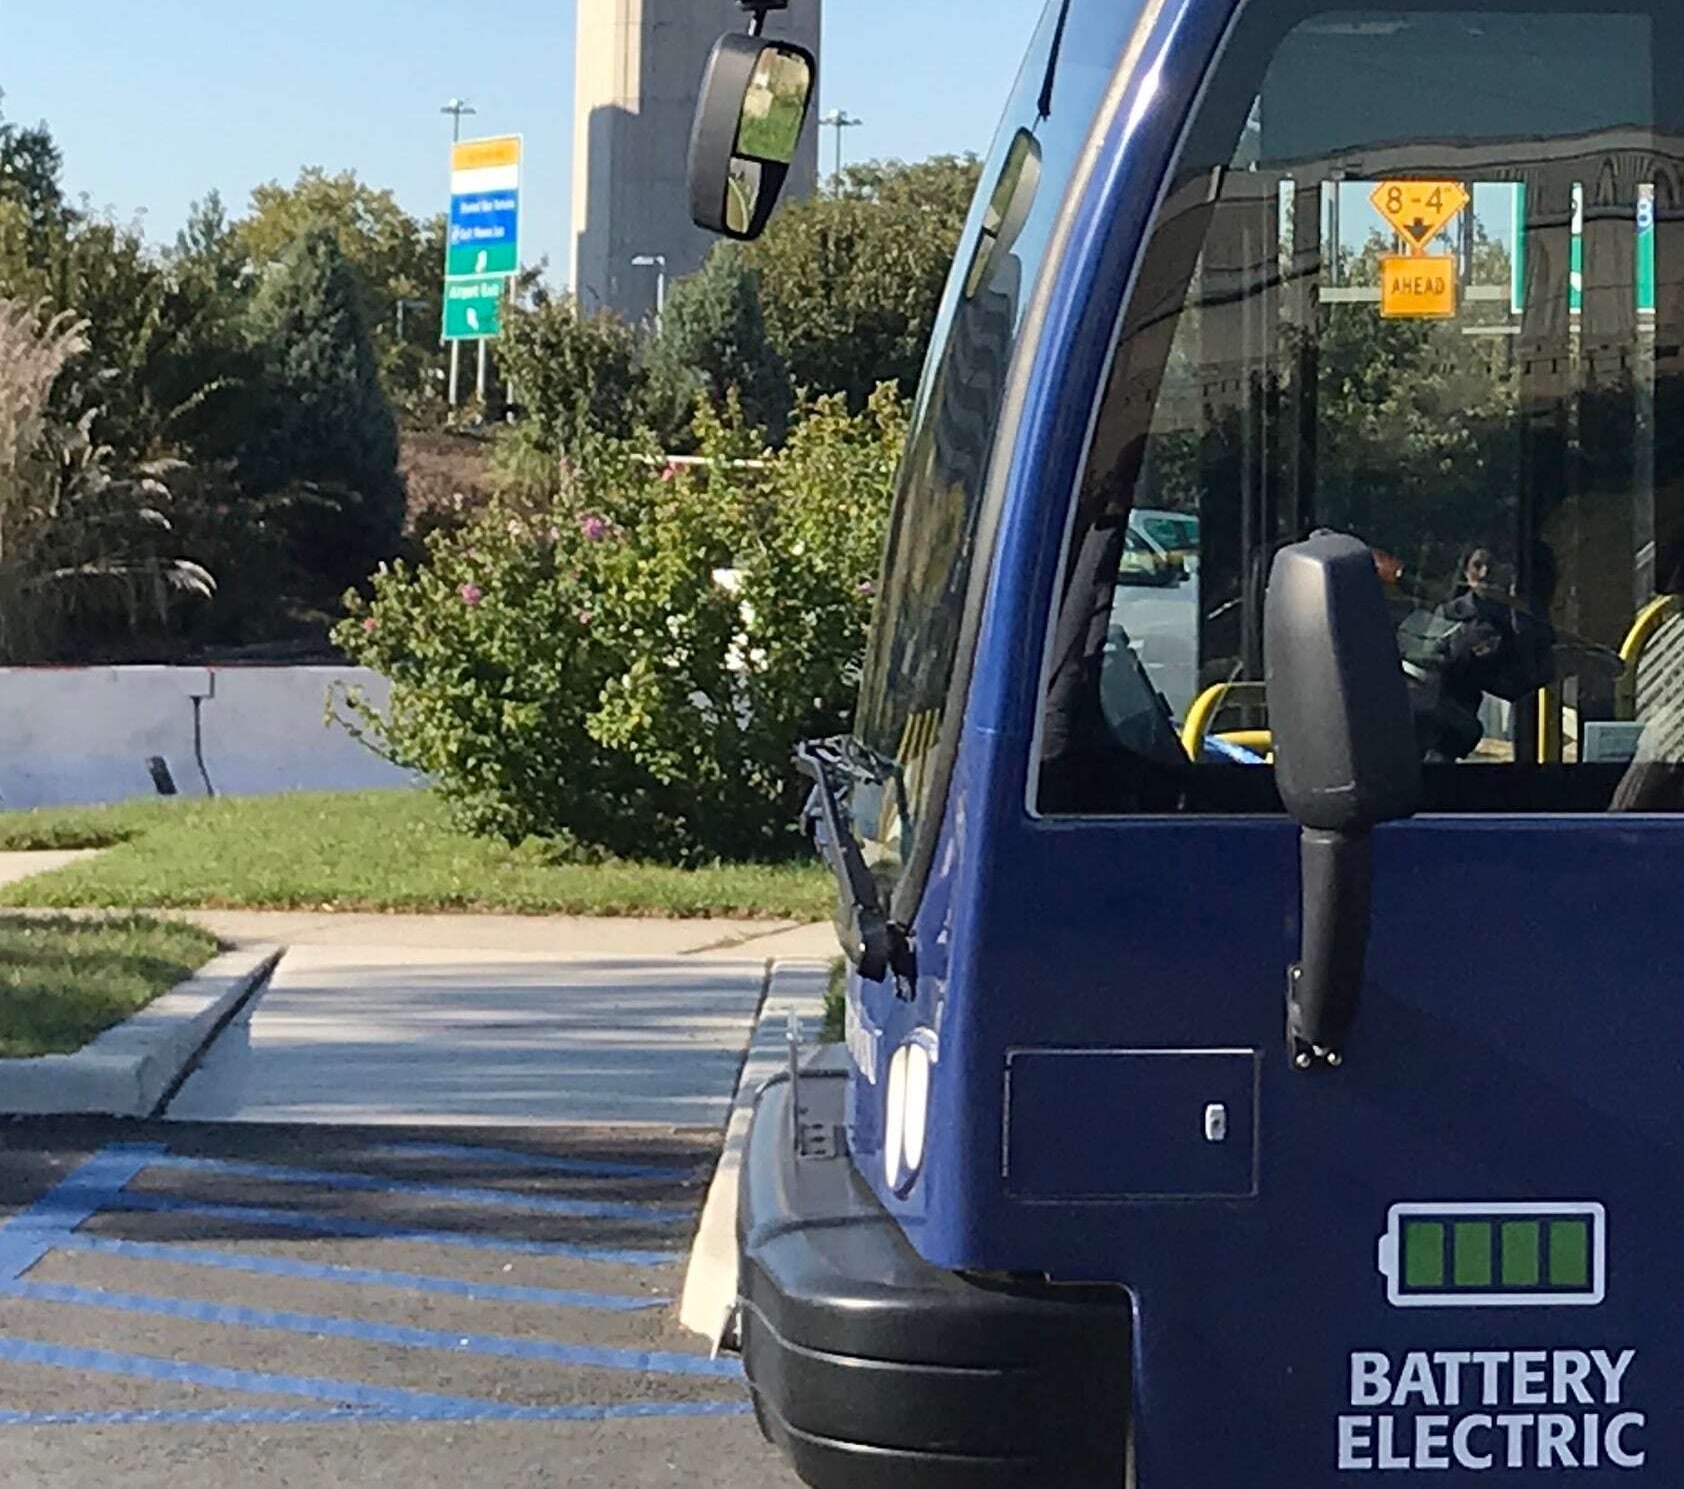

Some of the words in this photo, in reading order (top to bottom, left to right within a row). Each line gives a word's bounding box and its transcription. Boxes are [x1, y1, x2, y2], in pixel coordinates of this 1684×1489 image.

[1391, 277, 1446, 296] AHEAD
[1350, 1349, 1636, 1406] BATTERY
[1337, 1412, 1646, 1470] ELECTRIC
